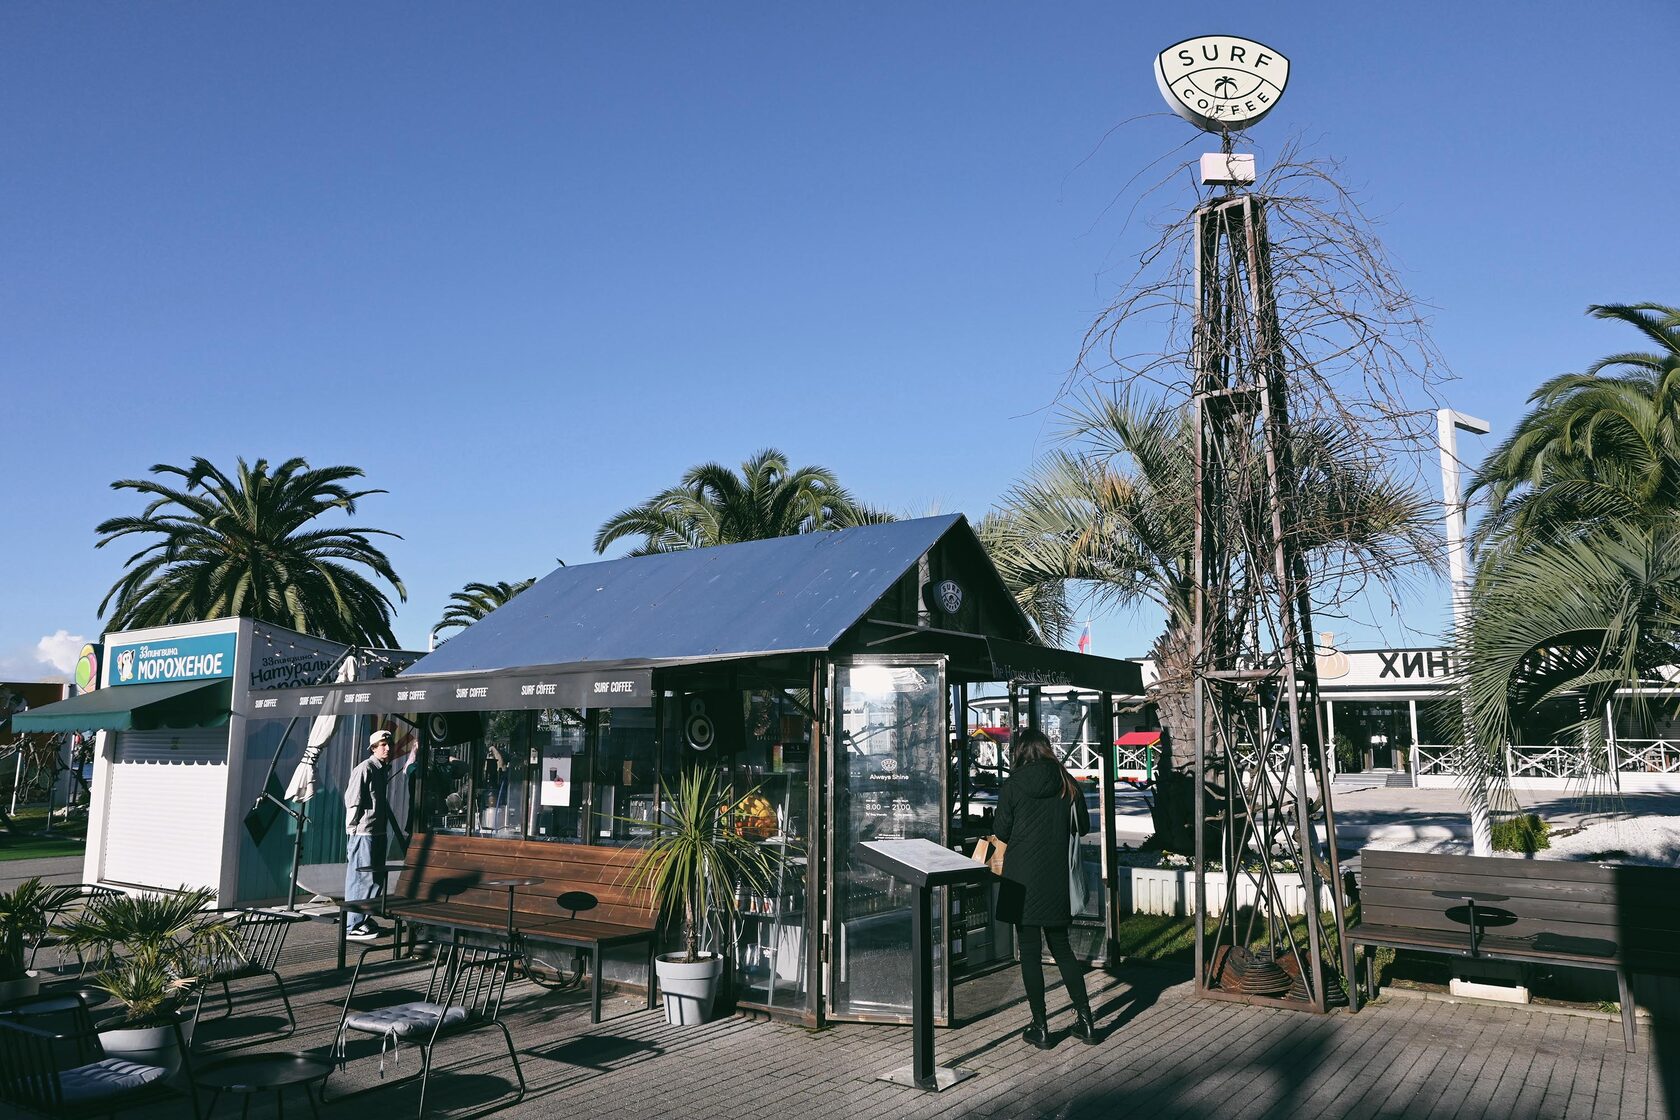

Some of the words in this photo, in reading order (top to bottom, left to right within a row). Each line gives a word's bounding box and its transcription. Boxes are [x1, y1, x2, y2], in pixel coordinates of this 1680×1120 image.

[1178, 44, 1273, 68] SURF
[1183, 88, 1270, 115] COFFEE
[942, 583, 960, 594] SURF
[137, 653, 224, 680] МОРОЖЕНОЕ
[1377, 652, 1456, 679] ХИН
[456, 688, 469, 698] SURF
[469, 687, 488, 698] COFFEE
[521, 685, 535, 695] SURF
[536, 684, 557, 695] COFFEE
[594, 682, 609, 693] SURF
[610, 681, 635, 693] COFFEE
[344, 693, 355, 703] SURF
[355, 693, 371, 703] COFFEE
[397, 691, 408, 701] SURF
[409, 690, 426, 700] COFFEE
